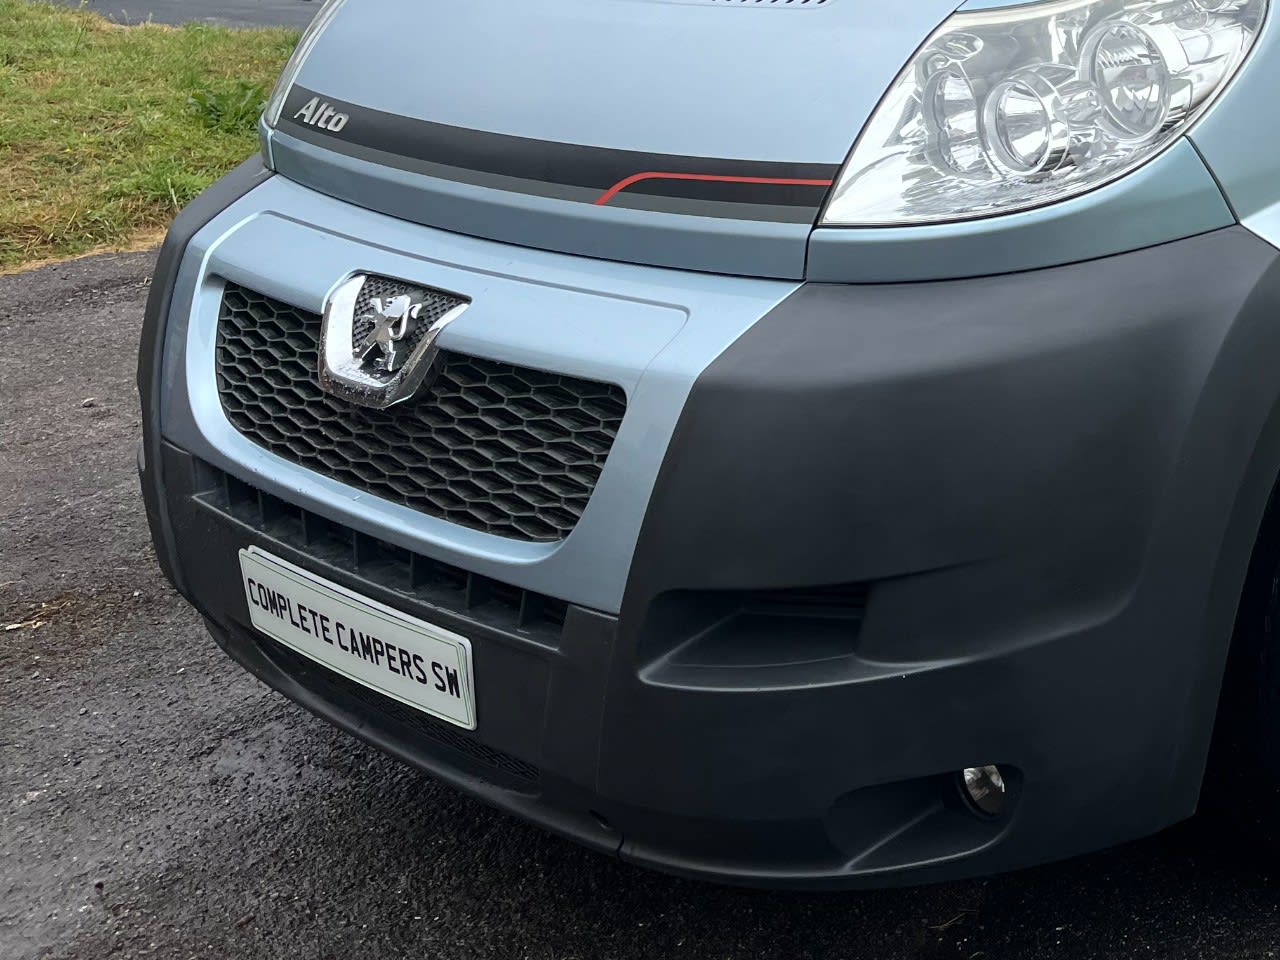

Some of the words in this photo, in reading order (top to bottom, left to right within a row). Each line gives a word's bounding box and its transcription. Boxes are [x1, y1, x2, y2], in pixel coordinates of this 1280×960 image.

[293, 96, 350, 132] Alto
[247, 578, 334, 645] COMPLETE
[335, 622, 428, 685] CAMPERS
[431, 661, 461, 699] SW
